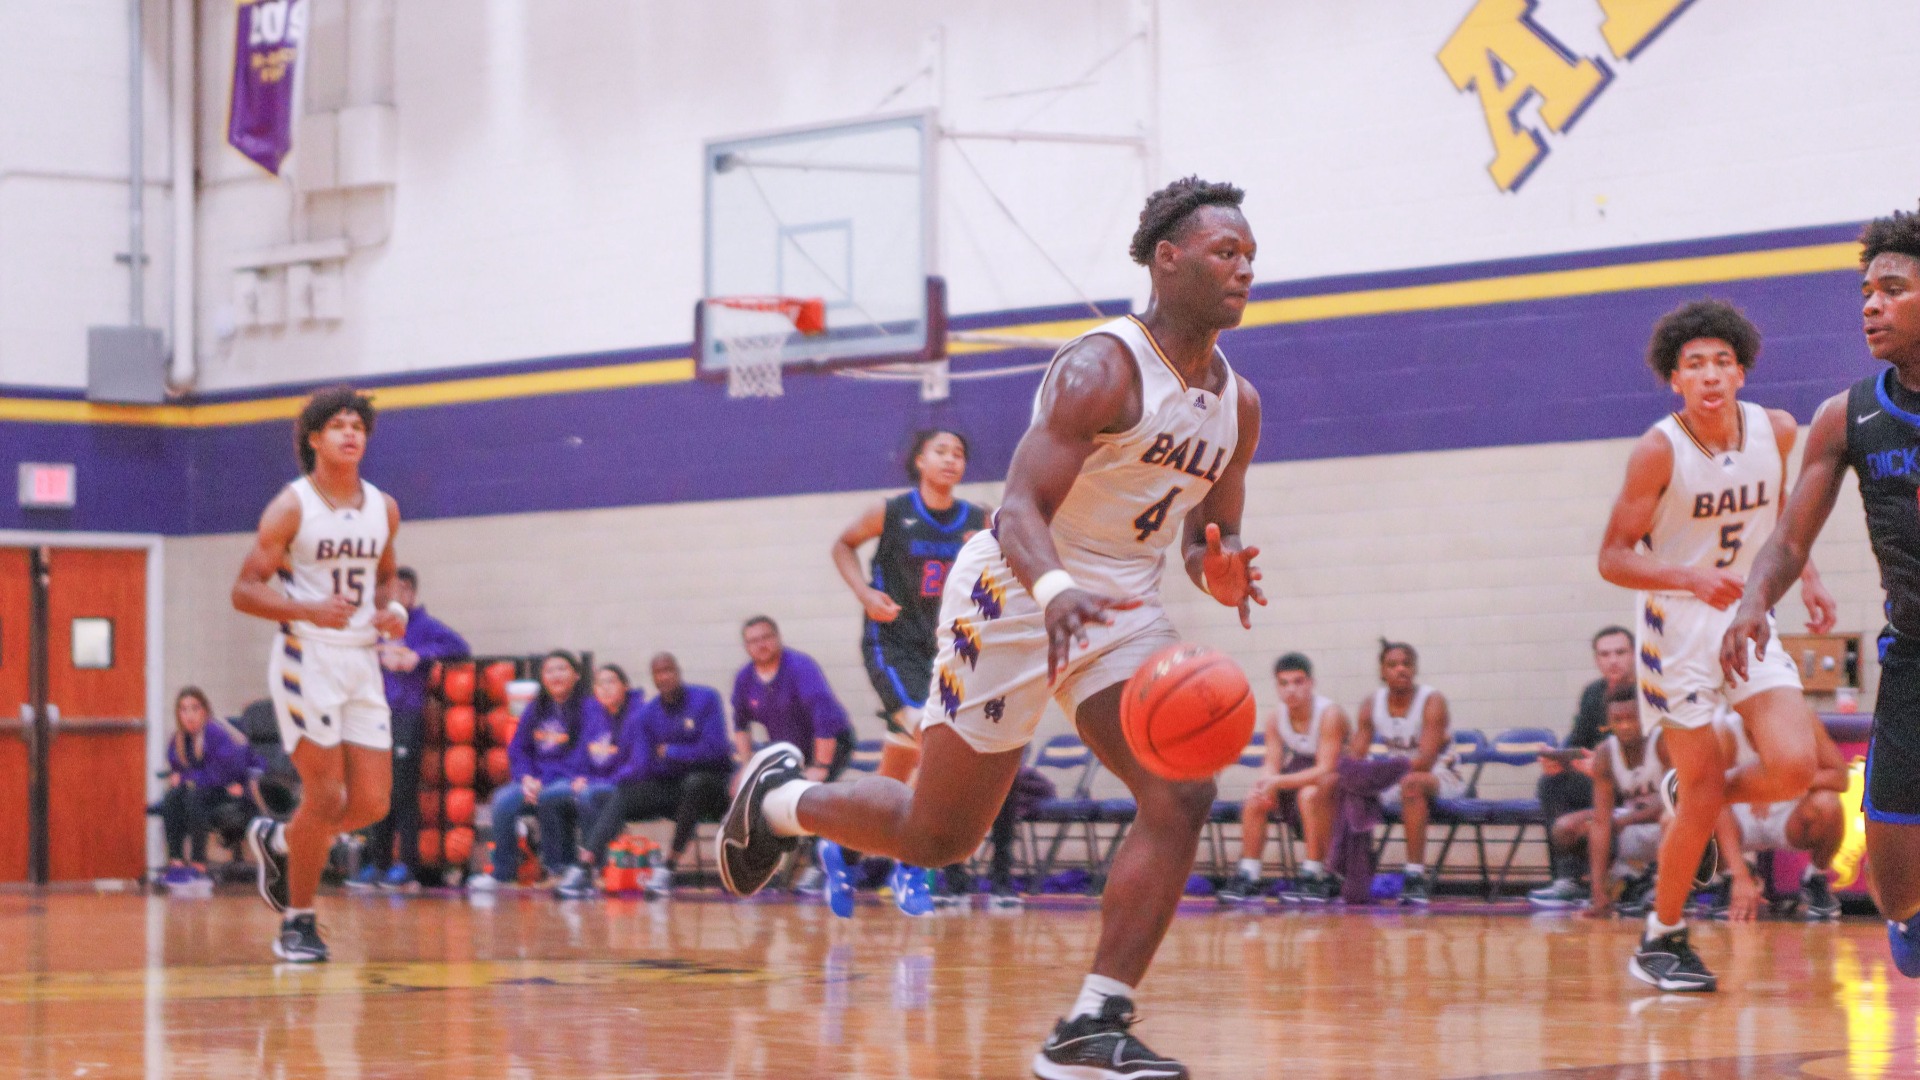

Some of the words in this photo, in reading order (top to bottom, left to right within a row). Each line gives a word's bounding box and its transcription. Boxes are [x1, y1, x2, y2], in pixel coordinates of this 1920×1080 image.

[1140, 432, 1226, 484] BALL
[1134, 486, 1183, 542] 4
[1692, 480, 1770, 518] BALL
[316, 538, 378, 560] BALL
[1715, 522, 1744, 568] 5
[332, 568, 366, 607] 15
